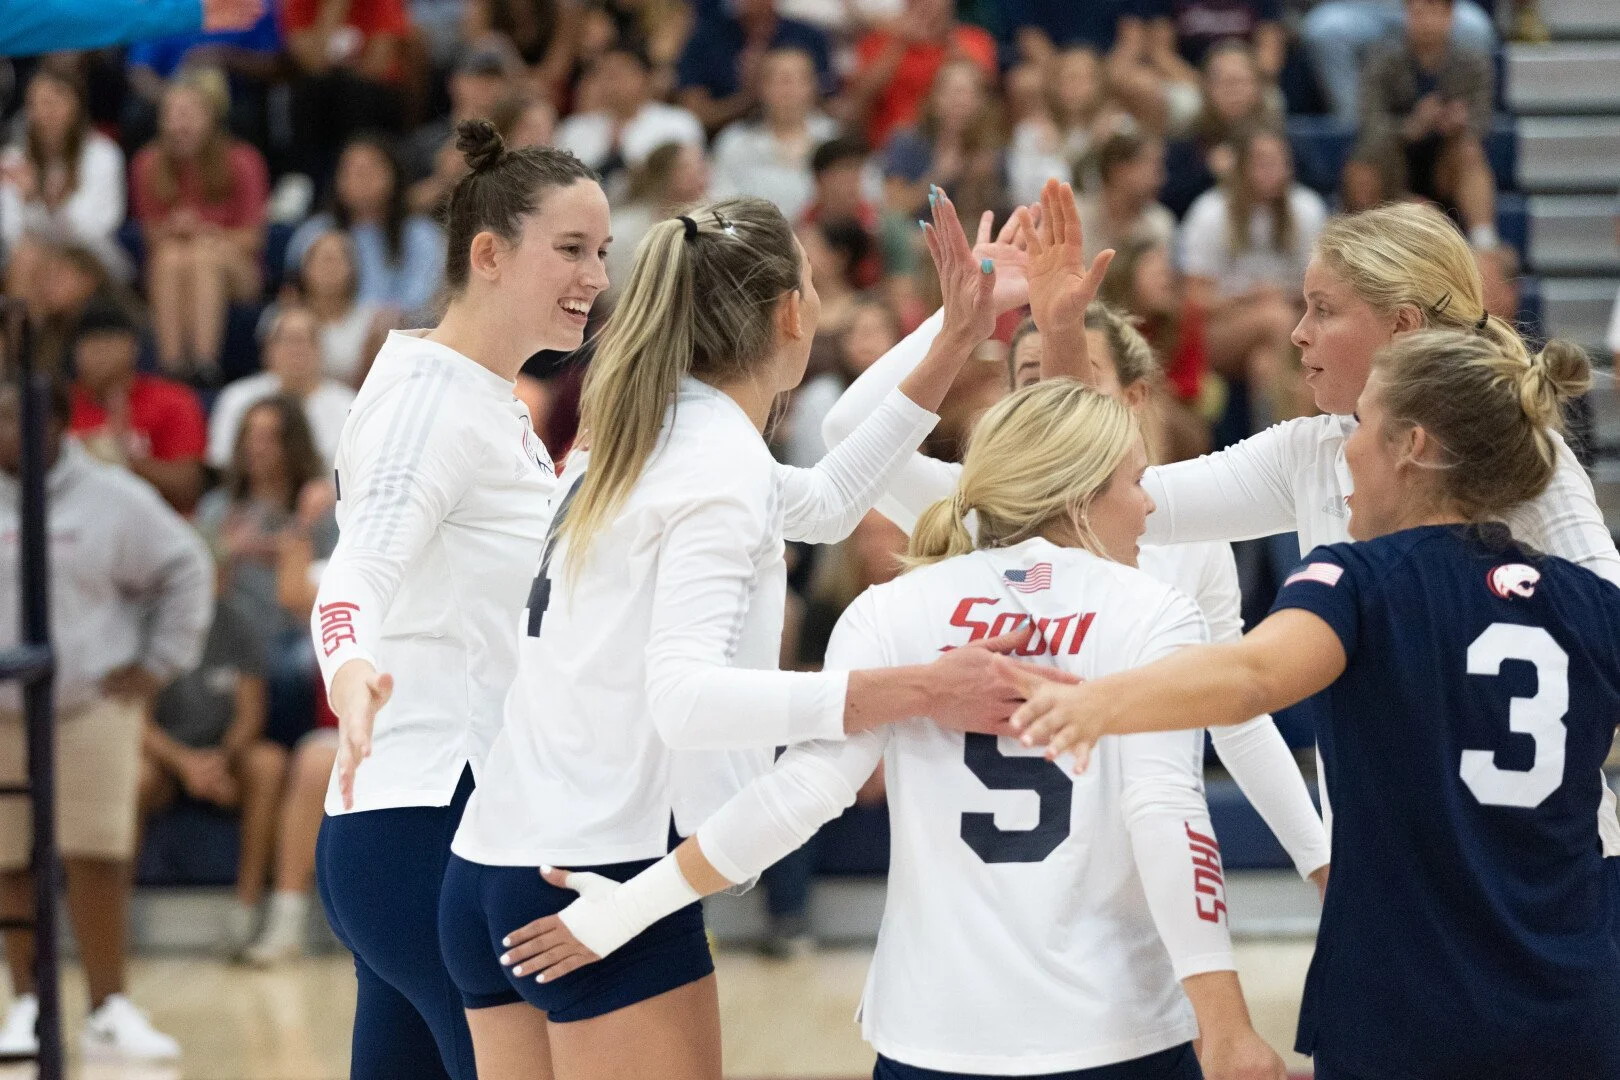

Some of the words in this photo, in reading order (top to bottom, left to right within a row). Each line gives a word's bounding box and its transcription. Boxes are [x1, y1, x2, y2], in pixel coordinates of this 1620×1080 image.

[319, 601, 360, 657] JAGS
[1459, 622, 1570, 809] 3
[960, 731, 1074, 864] 5
[1184, 820, 1227, 923] JAGS
